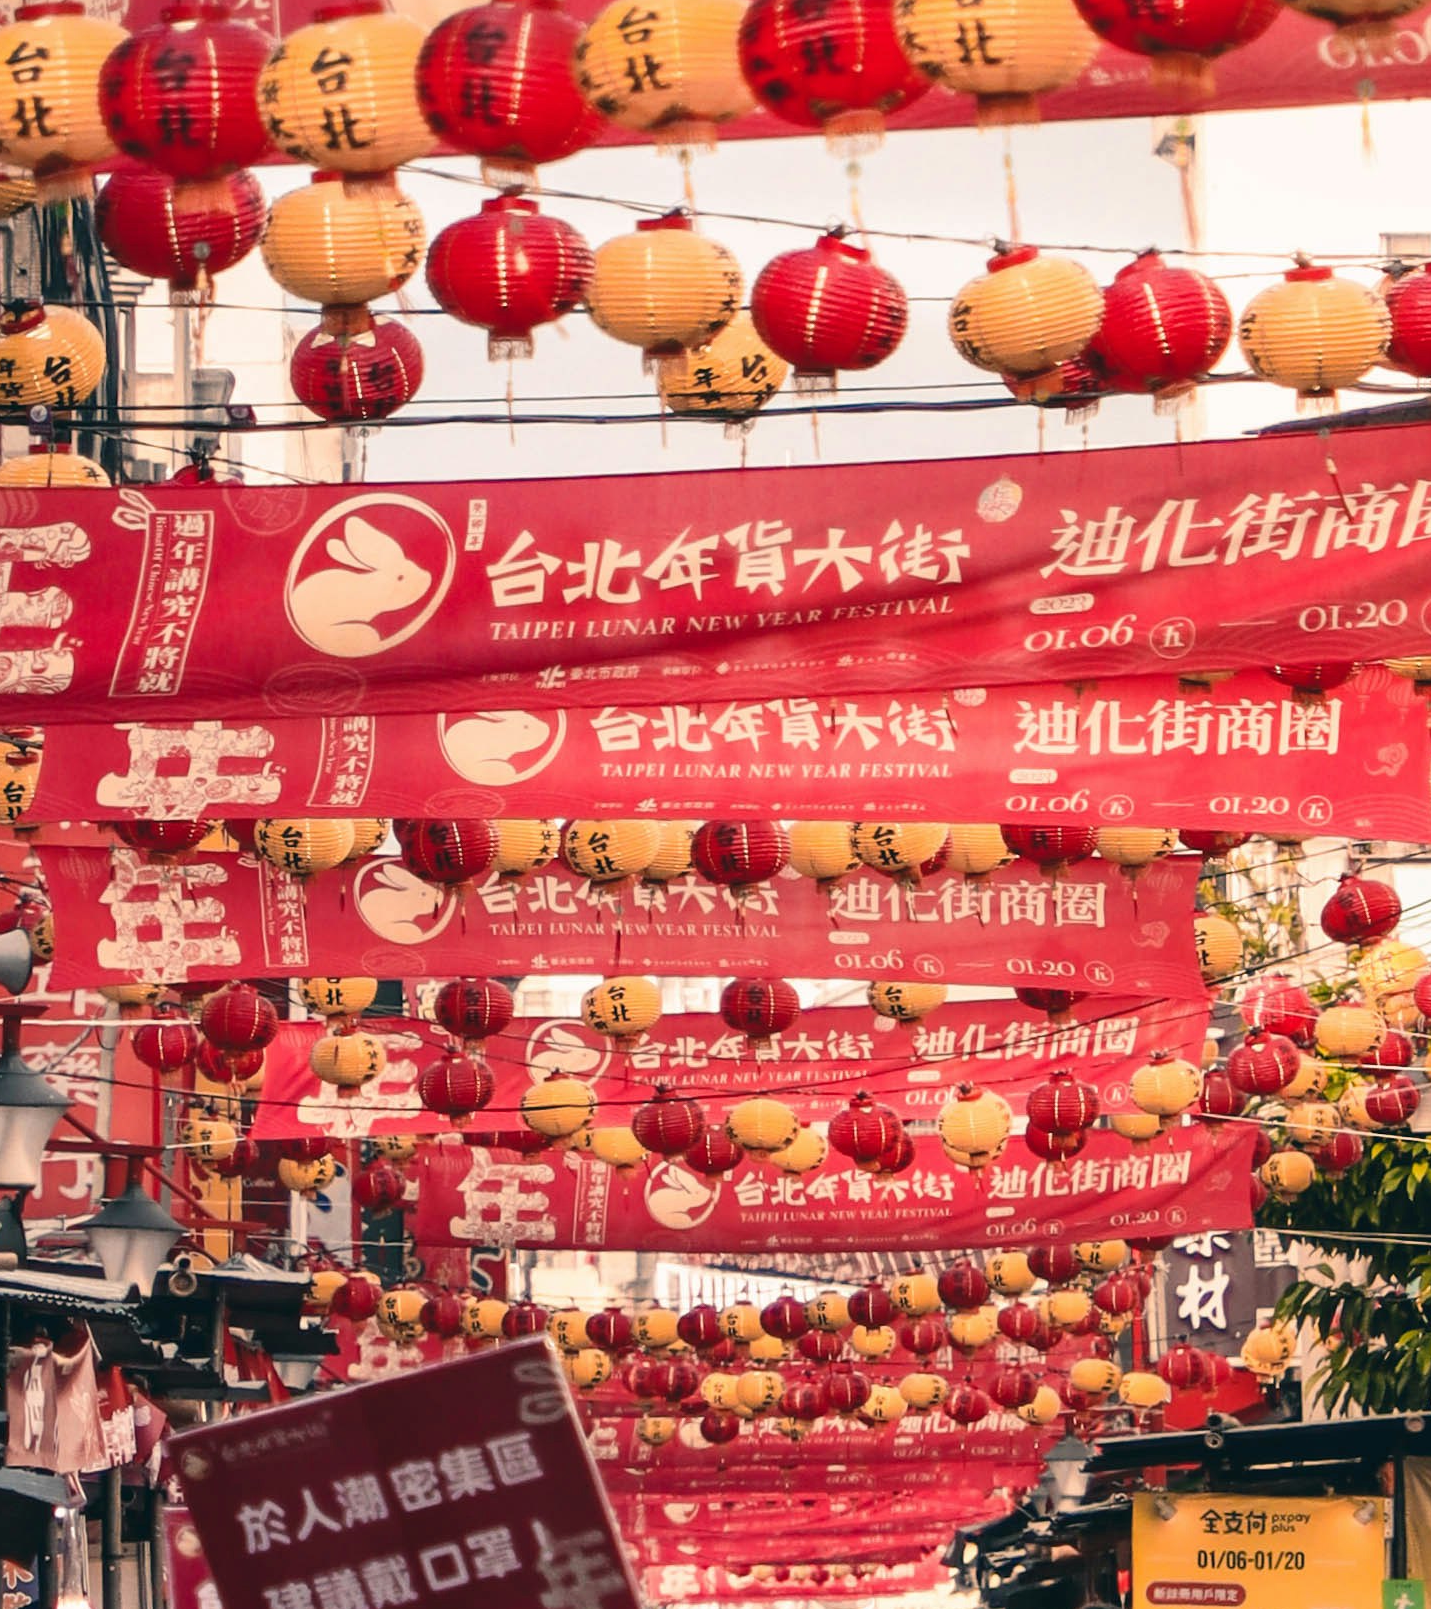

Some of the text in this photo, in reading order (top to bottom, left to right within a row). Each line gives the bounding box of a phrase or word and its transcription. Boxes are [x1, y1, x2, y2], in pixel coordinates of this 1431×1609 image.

[485, 519, 970, 607] 台北年貨大街
[136, 512, 206, 694] 過年講究不將就
[490, 594, 955, 641] TAIPEI LUNAR NEW YEAR FESTIVAL
[1024, 598, 1409, 653] 01.06 01.20
[589, 697, 958, 753] 台北年貨大街
[1013, 697, 1343, 756] 迪化街商圈
[599, 762, 953, 779] TAIPEI LUNAR NEW YEAR FESTIVAL
[1006, 788, 1291, 816] 01.06 01.20
[828, 878, 1107, 929] 迪化街商圈
[490, 923, 544, 936] TAIPEI
[549, 923, 605, 937] LUNAR
[655, 924, 697, 937] YEAR
[702, 924, 781, 938] FESTIVAL
[835, 947, 1076, 979] 01.06 01.20
[682, 1071, 730, 1086] LUNAR
[733, 1070, 765, 1084] NEW
[782, 1209, 825, 1222] LUNAR
[829, 1208, 858, 1221] NEW
[894, 1205, 953, 1219] FESTIVAL
[1110, 1208, 1159, 1226] 01.20
[237, 1431, 545, 1554] 於人潮密集區
[1200, 1508, 1312, 1535] 全支付 pxpay
[1271, 1522, 1296, 1534] plus
[1197, 1549, 1306, 1572] 01/06-01/20
